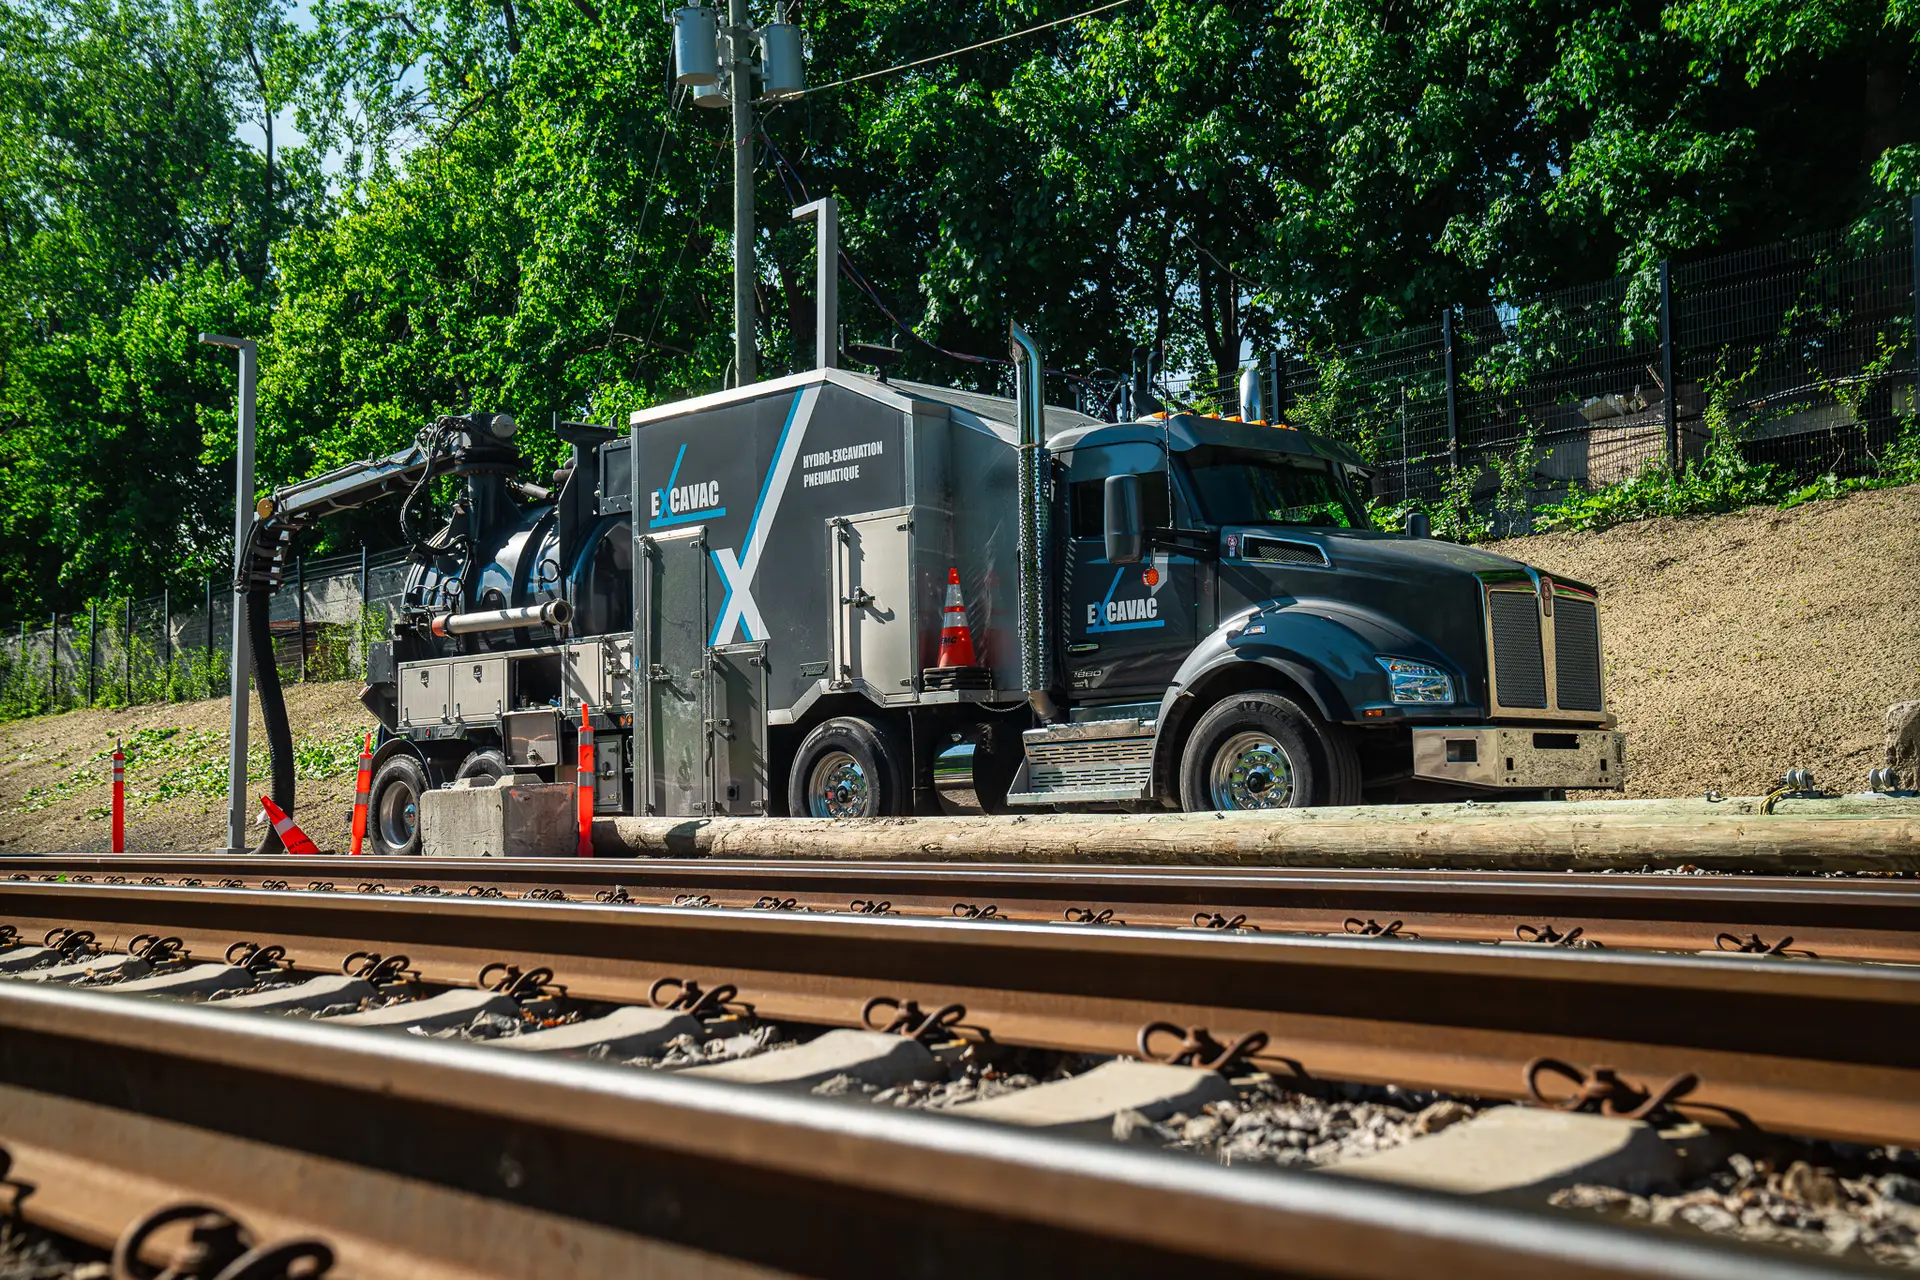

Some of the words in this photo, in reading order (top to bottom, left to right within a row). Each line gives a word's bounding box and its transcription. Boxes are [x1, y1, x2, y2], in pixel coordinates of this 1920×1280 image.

[803, 440, 883, 469] HYDRO-EXCAVATION
[803, 464, 860, 488] PNEUMATIQUE
[651, 479, 719, 519] EXCAVAC
[1087, 597, 1158, 627] EXCAVAC
